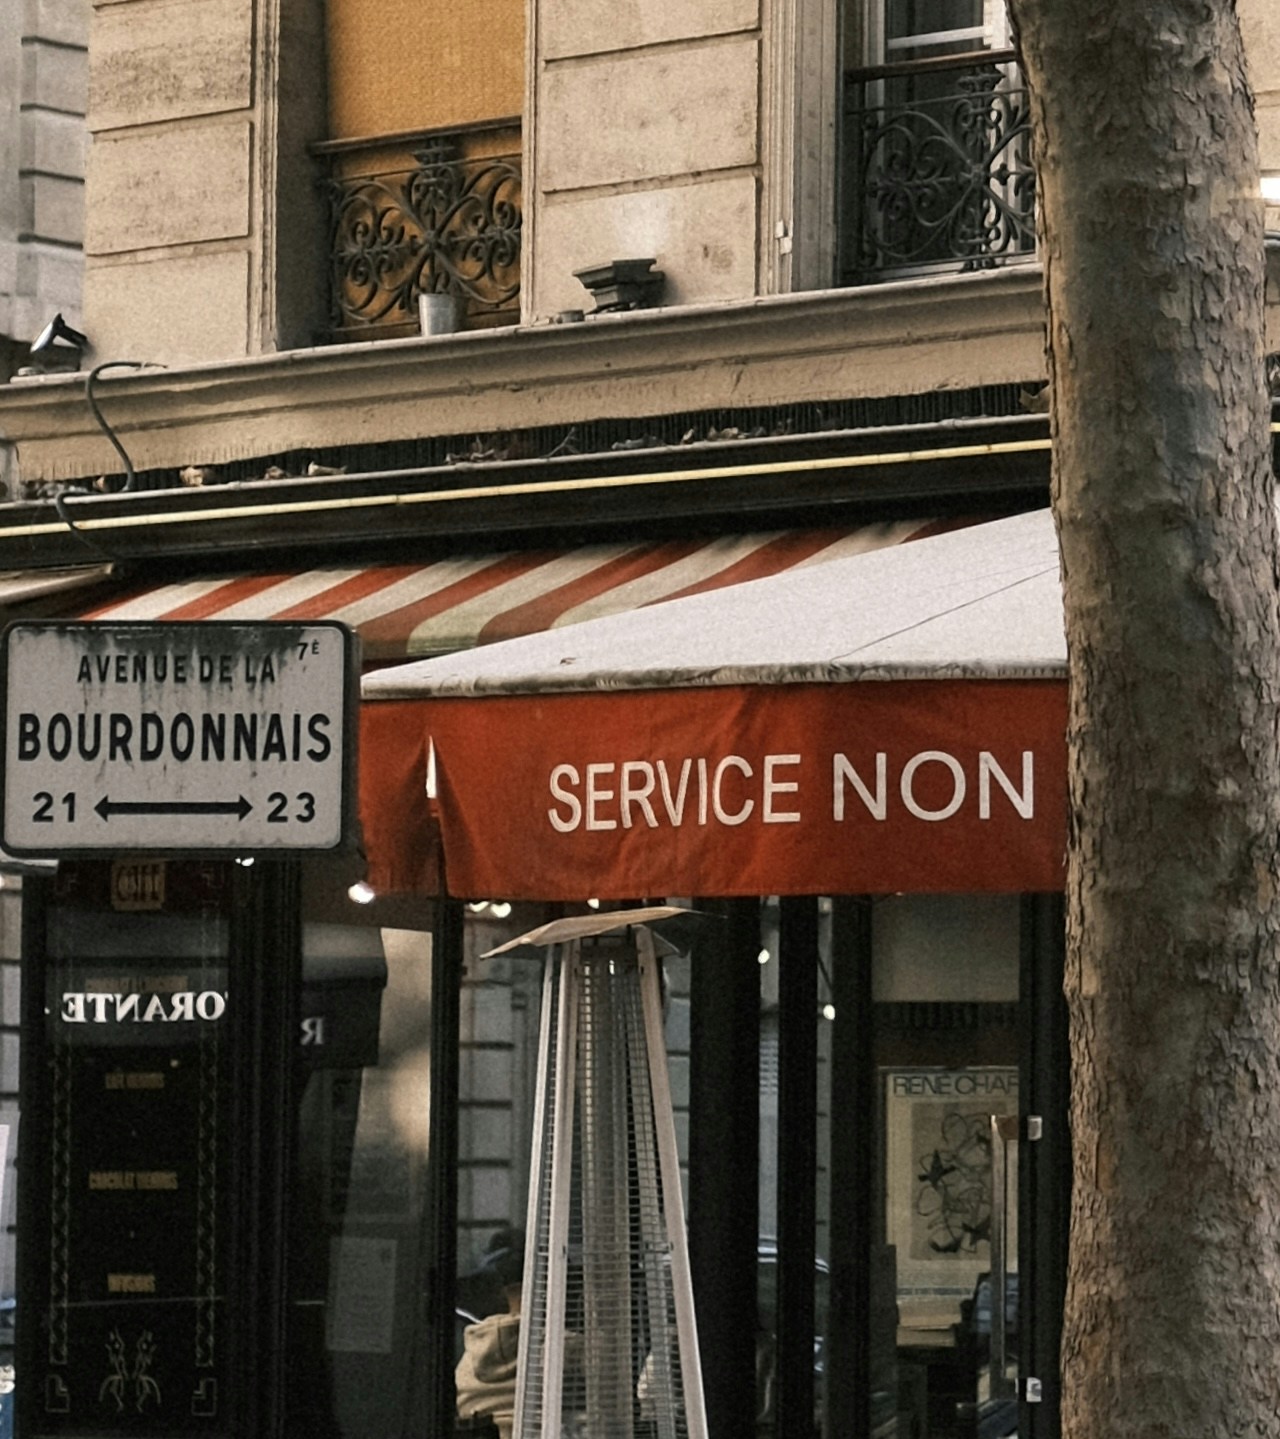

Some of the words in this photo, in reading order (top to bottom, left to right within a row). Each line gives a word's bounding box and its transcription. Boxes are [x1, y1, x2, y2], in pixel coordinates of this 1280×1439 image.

[77, 655, 188, 684] AVENUE
[198, 655, 233, 683] DE
[244, 655, 276, 682] LA
[18, 712, 332, 762] BOURDONNAIS
[32, 791, 76, 823] 21
[266, 791, 317, 823] 23
[547, 754, 801, 832] SERVICE
[832, 750, 1035, 821] NON
